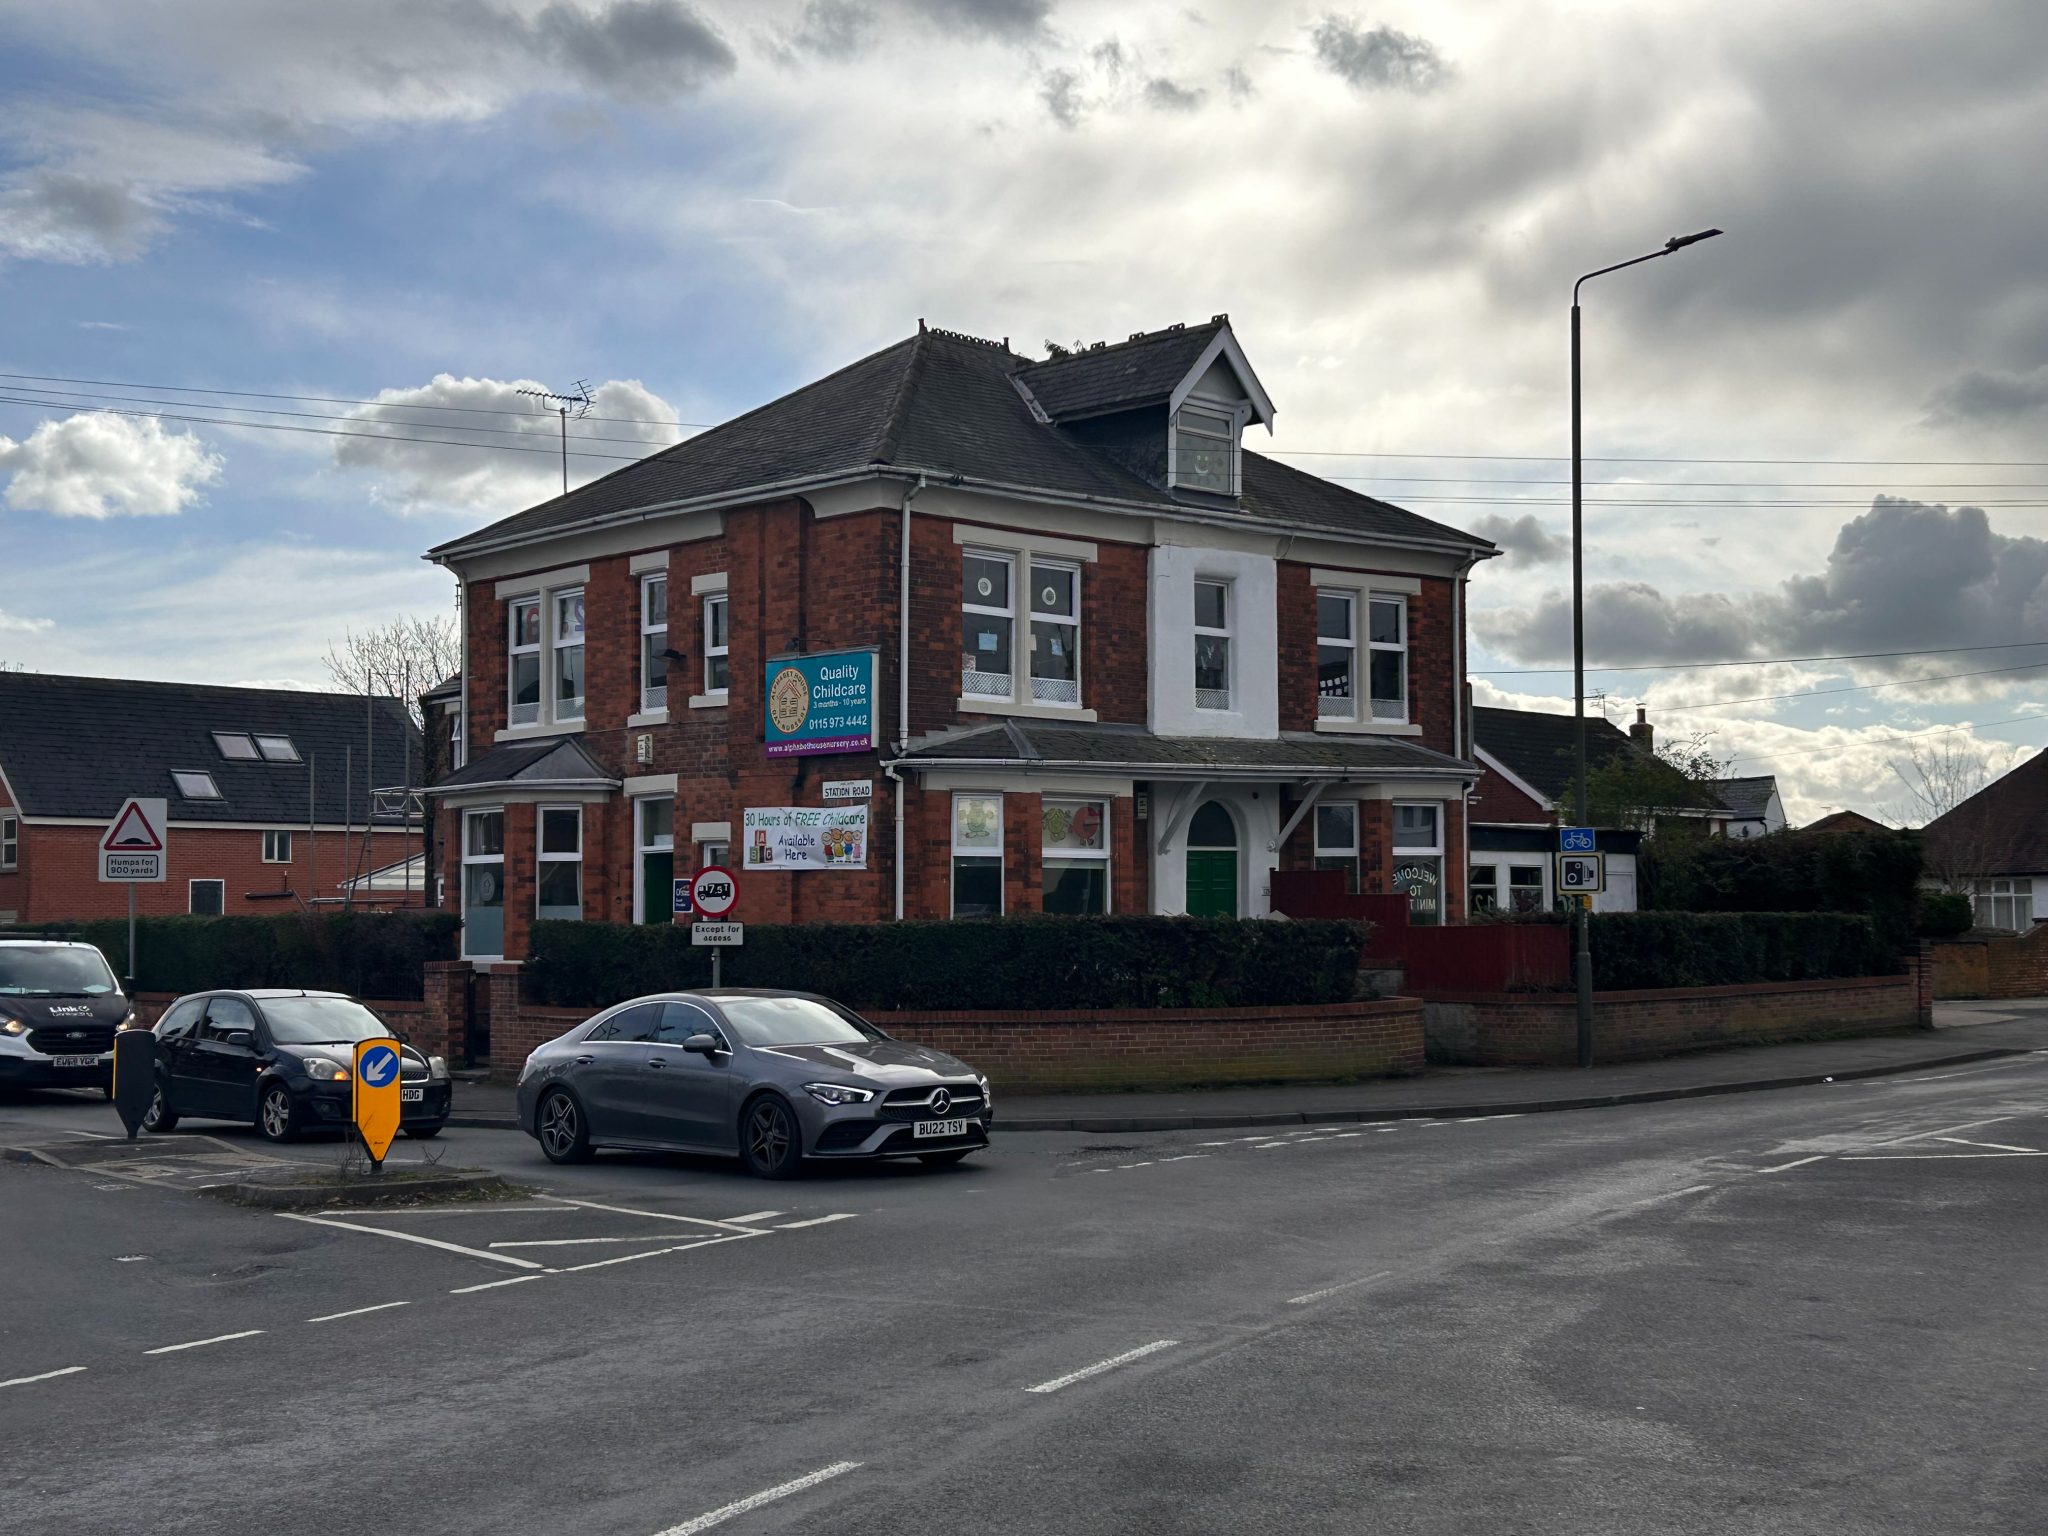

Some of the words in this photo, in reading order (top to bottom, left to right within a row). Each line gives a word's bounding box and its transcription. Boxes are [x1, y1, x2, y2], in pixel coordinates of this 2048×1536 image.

[820, 665, 859, 681] Quality
[813, 684, 866, 699] Childcare
[813, 701, 818, 709] 3
[818, 699, 839, 709] months
[843, 698, 850, 706] 10
[850, 698, 867, 707] years
[809, 719, 828, 730] 0115
[829, 717, 844, 729] 973
[846, 715, 867, 726] 4442
[825, 787, 850, 797] STATION
[852, 786, 870, 796] ROAD
[745, 813, 755, 826] 30
[758, 813, 780, 826] Hours
[783, 812, 792, 827] of
[796, 812, 821, 826] FREE
[822, 812, 865, 826] Childcare
[778, 834, 815, 847] Available
[784, 849, 807, 860] Here
[695, 925, 724, 933] Except
[728, 925, 740, 933] for
[919, 1123, 944, 1135] BU22
[947, 1120, 962, 1133] TSY
